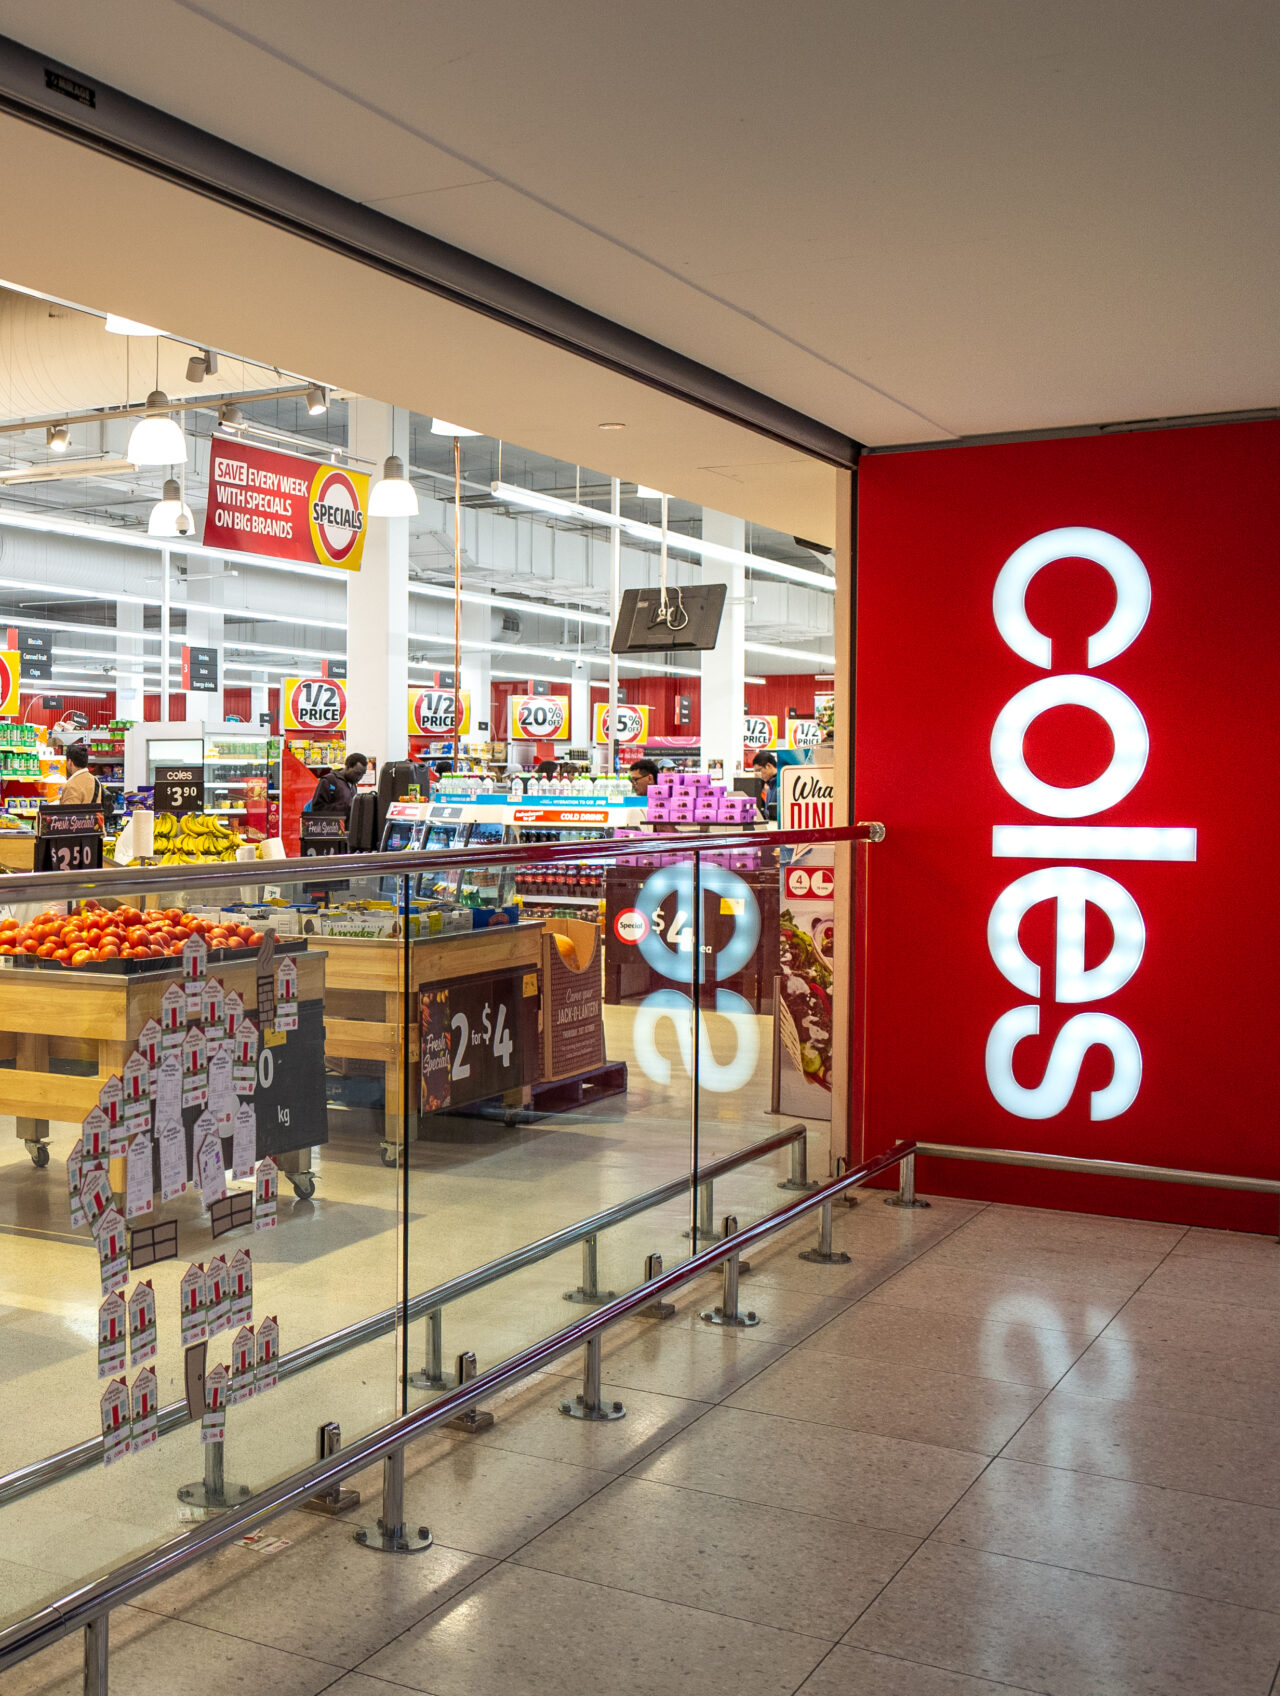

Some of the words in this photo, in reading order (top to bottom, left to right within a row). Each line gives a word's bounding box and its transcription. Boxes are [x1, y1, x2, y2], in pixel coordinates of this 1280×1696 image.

[217, 461, 245, 483] SAVE
[248, 468, 280, 491] EVERY
[280, 475, 309, 498] WEEK
[216, 484, 245, 508] WITH
[246, 491, 292, 517] SPECIALS
[214, 508, 233, 529] ON
[234, 512, 251, 532] BIG
[251, 515, 293, 540] BRANDS
[312, 501, 364, 531] SPECIALS
[27, 637, 43, 646] Biscuits
[23, 652, 38, 660] Canned
[38, 653, 48, 661] fruit
[183, 664, 188, 673] 3
[300, 681, 338, 709] 1/2
[423, 692, 456, 715] 1/2
[299, 707, 340, 721] PRICE
[421, 715, 456, 727] PRICE
[520, 706, 561, 727] 20%
[547, 718, 562, 727] OFF
[745, 719, 767, 735] 1/2
[799, 722, 819, 738] 1/2
[743, 735, 768, 744] PRICE
[166, 770, 193, 780] coles
[50, 815, 70, 831] Fresh
[69, 815, 95, 832] Specials
[560, 812, 580, 821] COLD
[580, 813, 605, 822] DRINK
[985, 525, 1198, 1122] coles
[308, 821, 321, 834] Fresh
[321, 821, 339, 836] Specials
[795, 873, 803, 885] 4
[619, 920, 644, 931] Special
[699, 945, 713, 954] ea
[556, 999, 599, 1025] JACK-O-LANTERN
[426, 1032, 446, 1053] Fresh
[450, 1012, 471, 1081] 2
[471, 1029, 482, 1046] for
[482, 1002, 513, 1068] $4
[423, 1050, 451, 1077] Specials
[277, 1104, 291, 1127] kg
